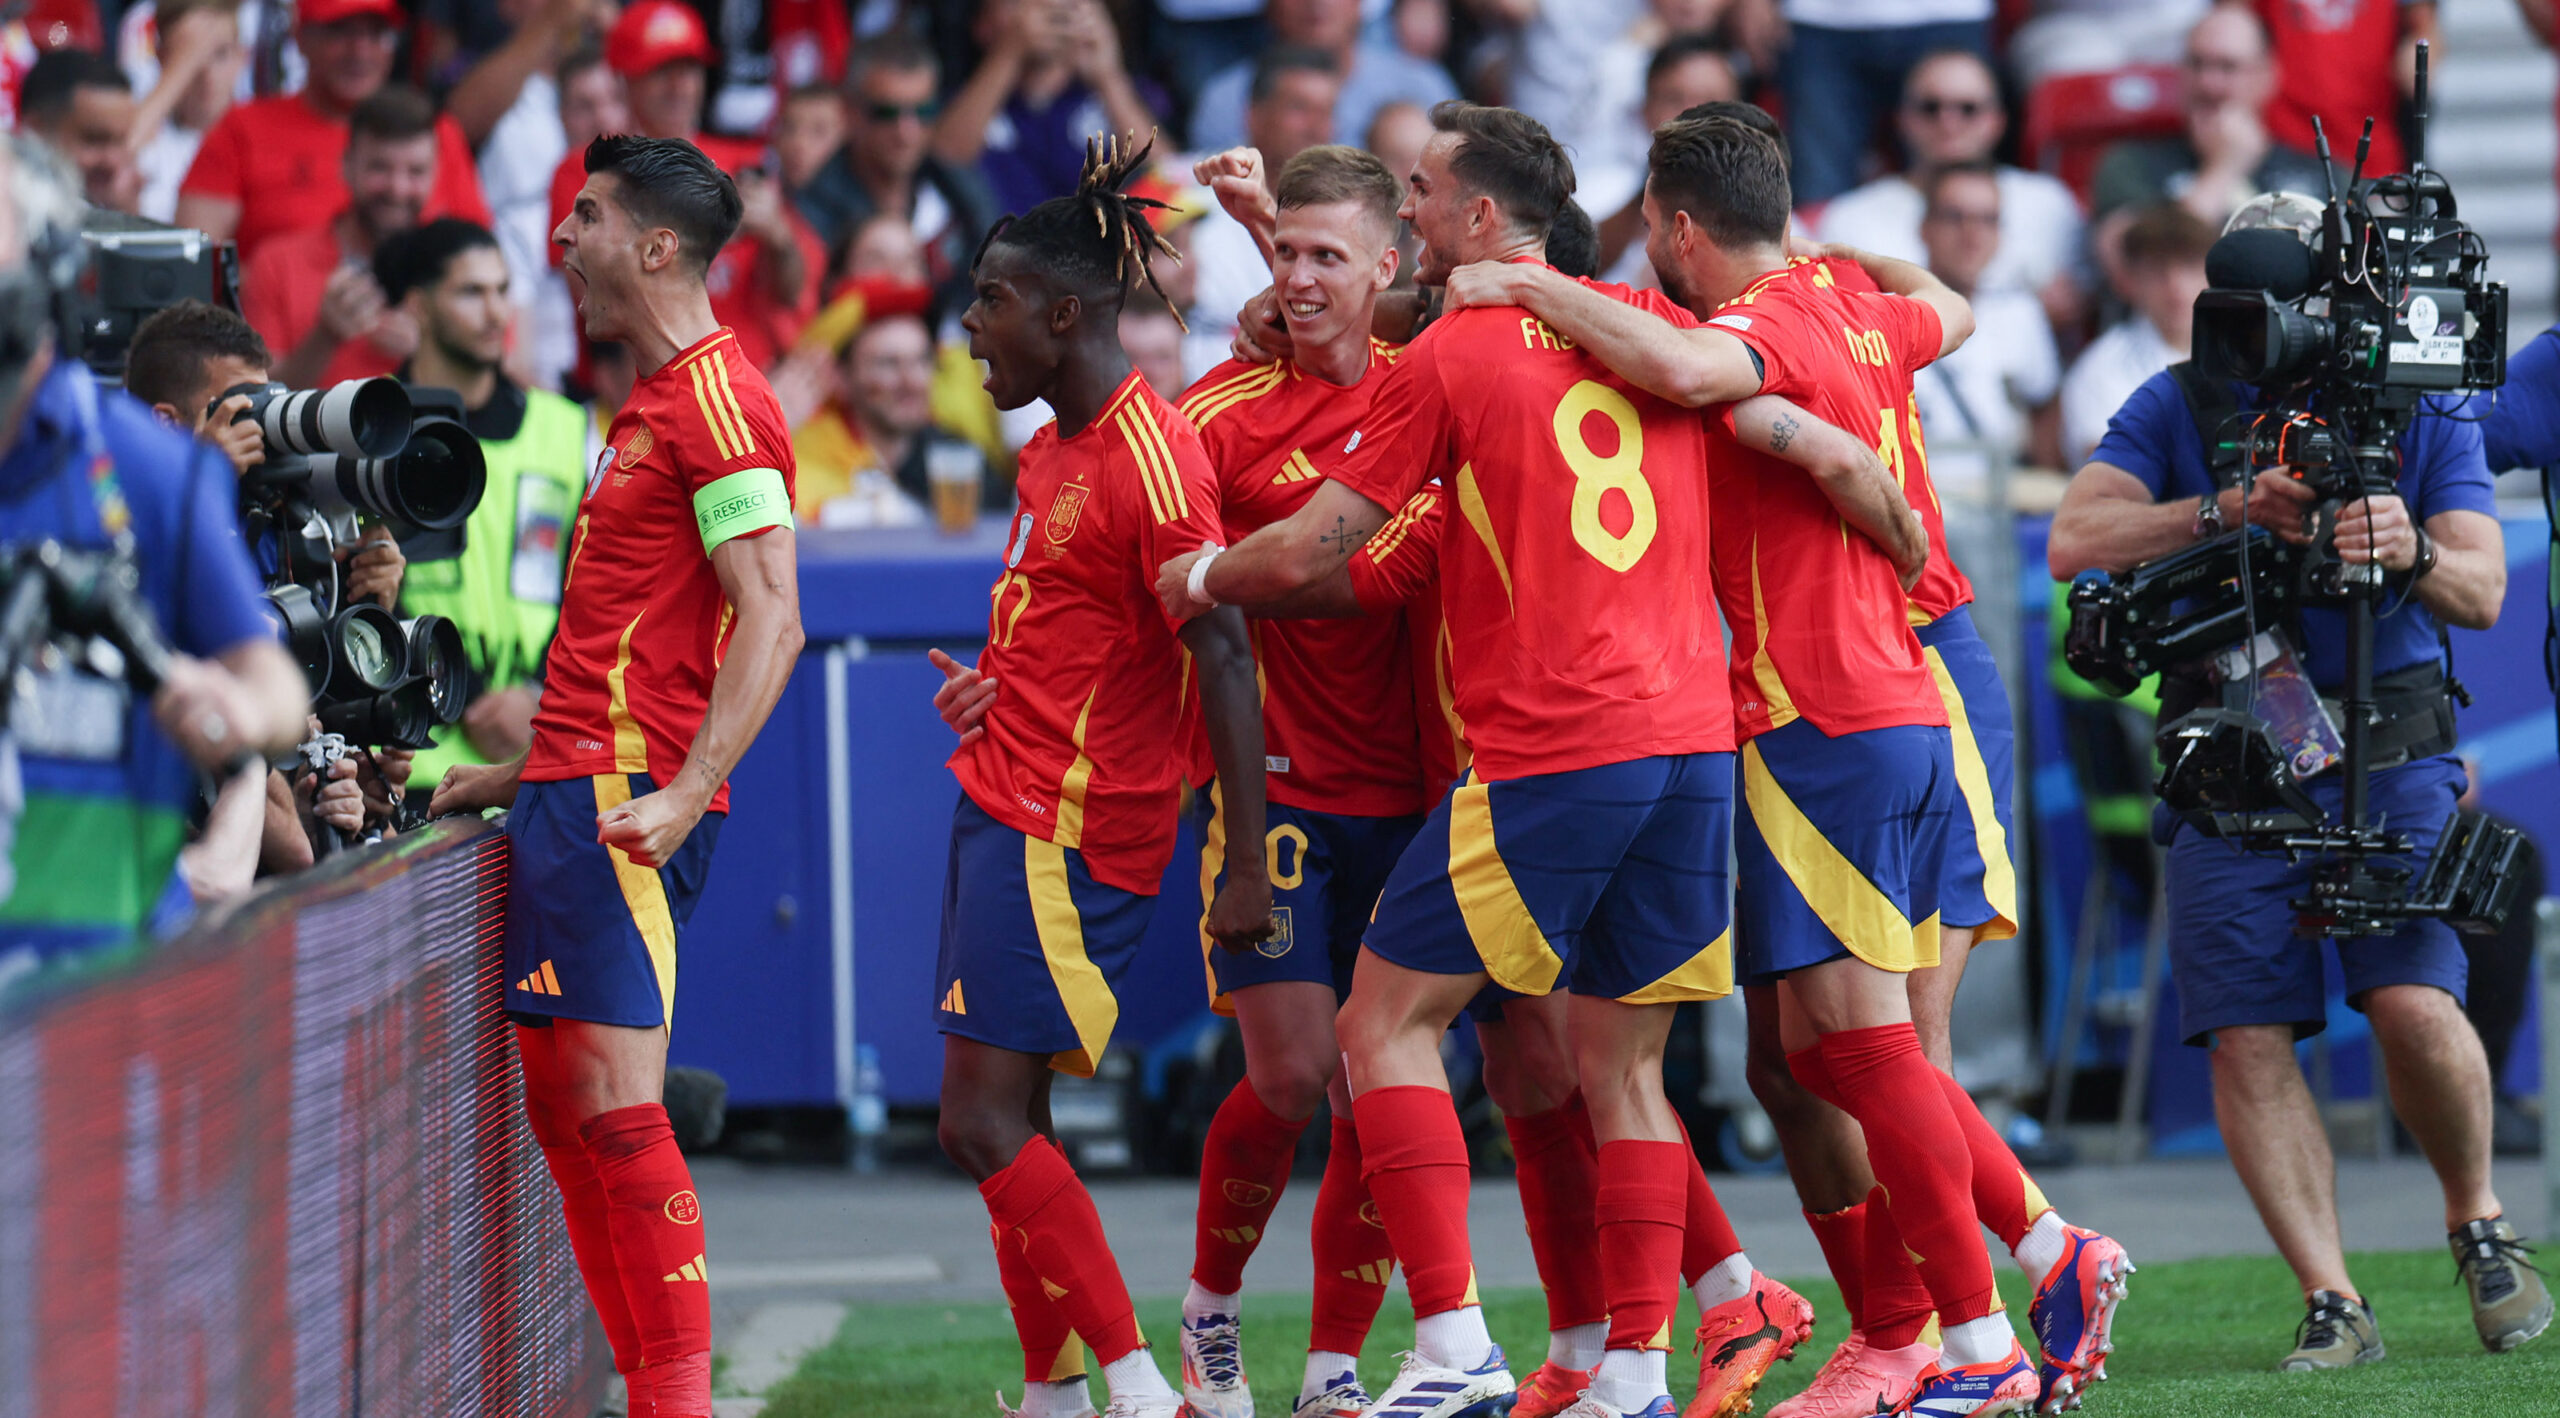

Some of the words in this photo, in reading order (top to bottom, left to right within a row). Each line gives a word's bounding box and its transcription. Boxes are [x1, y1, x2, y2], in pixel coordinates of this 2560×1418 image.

[713, 494, 766, 521] RESPECT
[1553, 379, 1658, 573] 8
[991, 570, 1032, 648] 17
